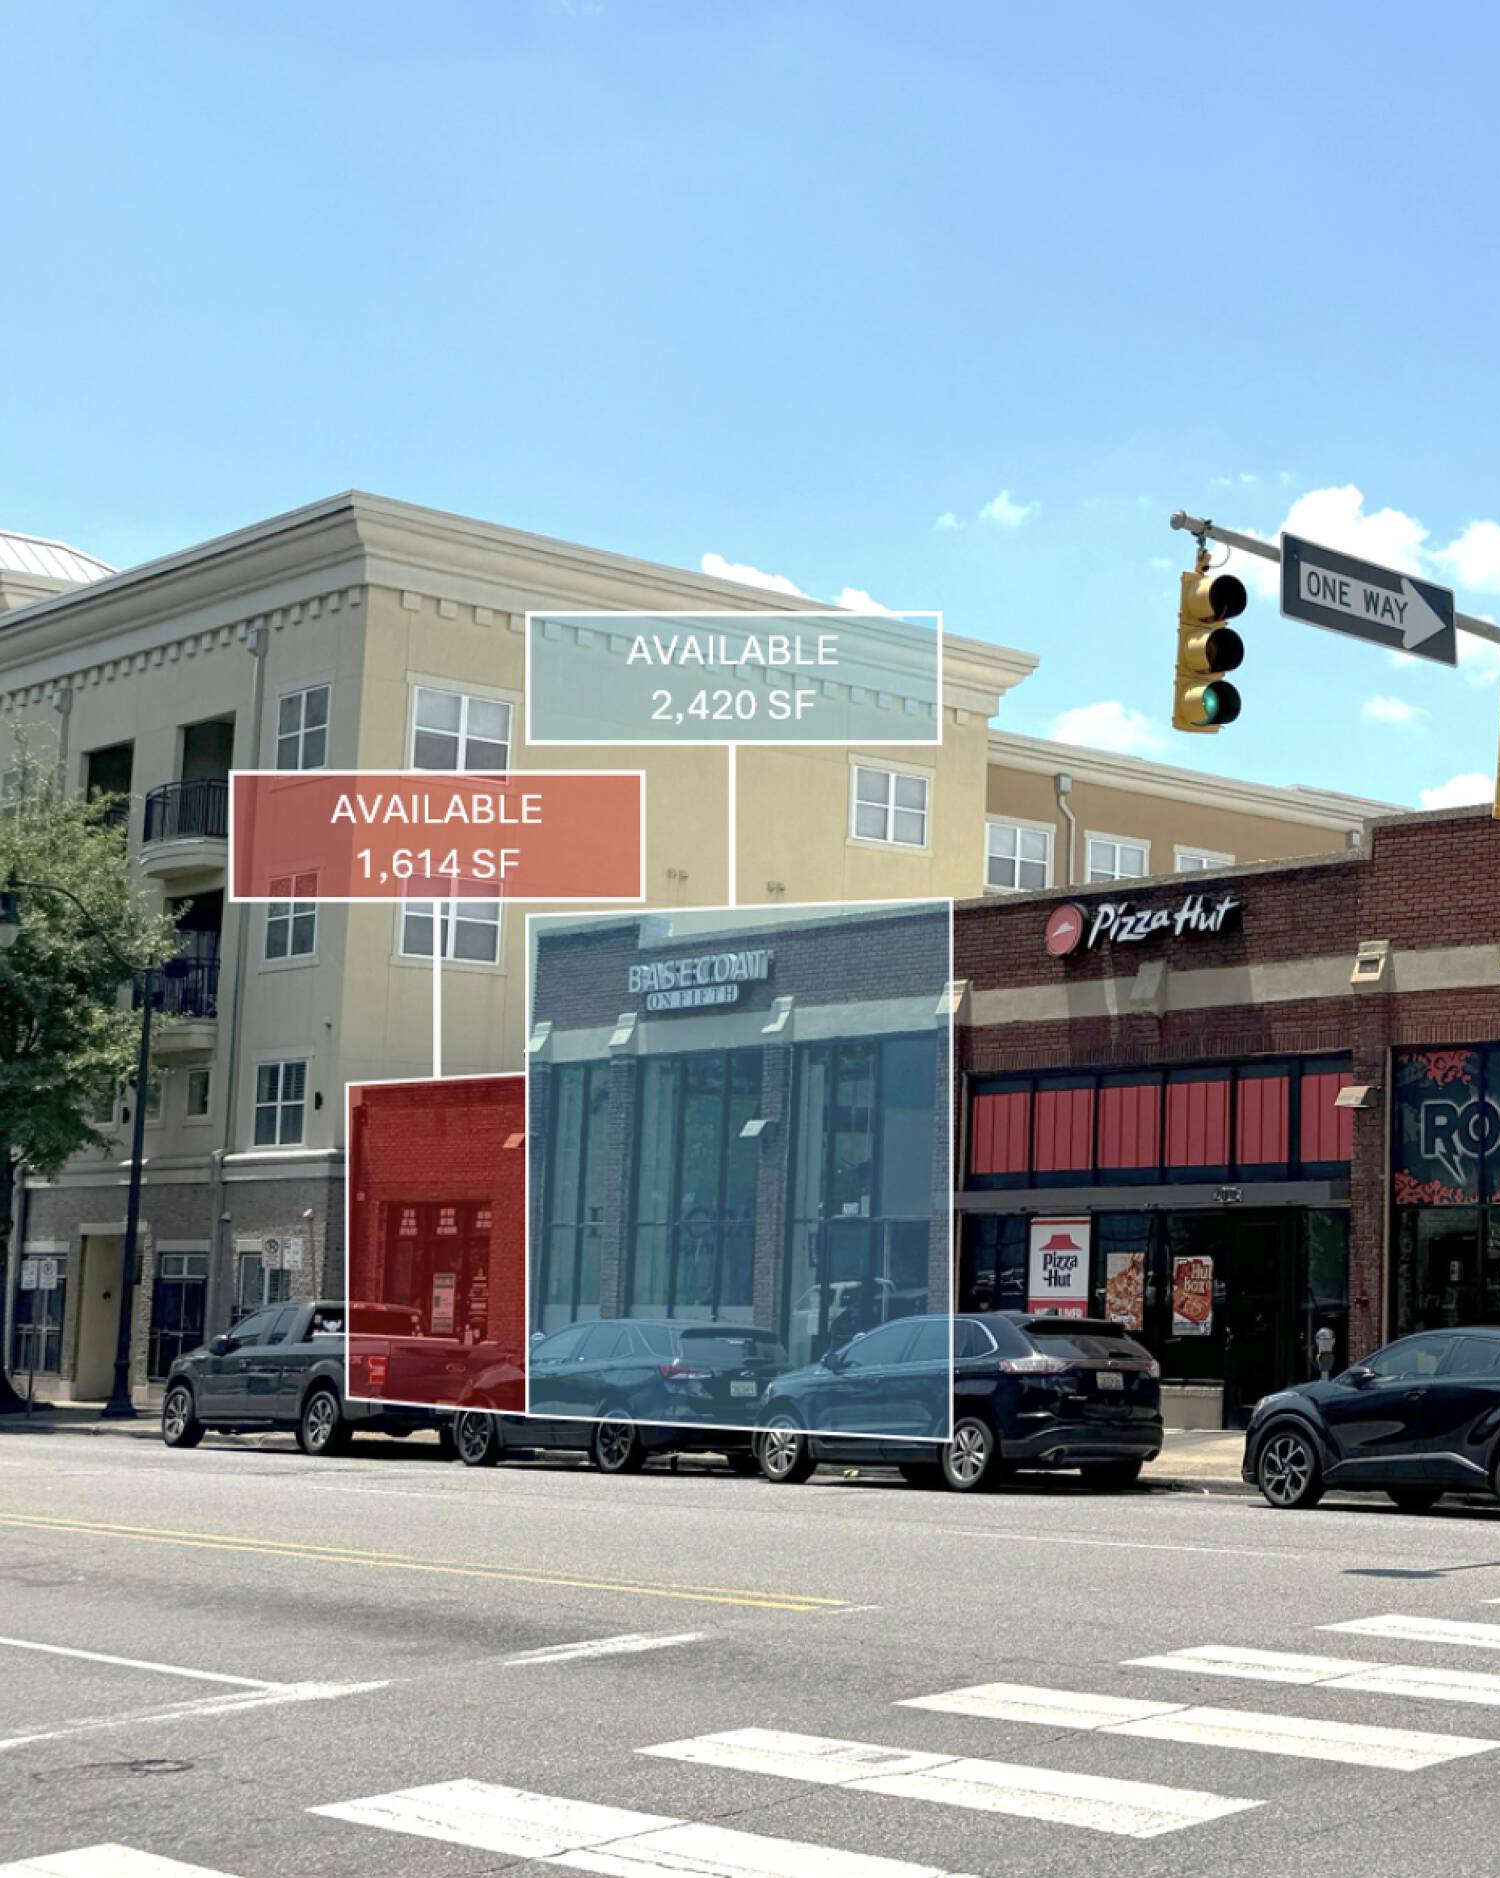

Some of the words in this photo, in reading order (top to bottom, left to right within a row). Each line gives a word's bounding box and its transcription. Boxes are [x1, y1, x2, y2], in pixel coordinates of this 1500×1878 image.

[1307, 571, 1352, 608] ONE
[1362, 588, 1409, 625] WAY
[1087, 902, 1171, 950] Pizza
[1173, 894, 1241, 937] Hut
[628, 949, 774, 993] BASECOAT
[651, 993, 673, 1009] ON
[1042, 1251, 1078, 1271] Pizza
[1042, 1269, 1072, 1288] Hut
